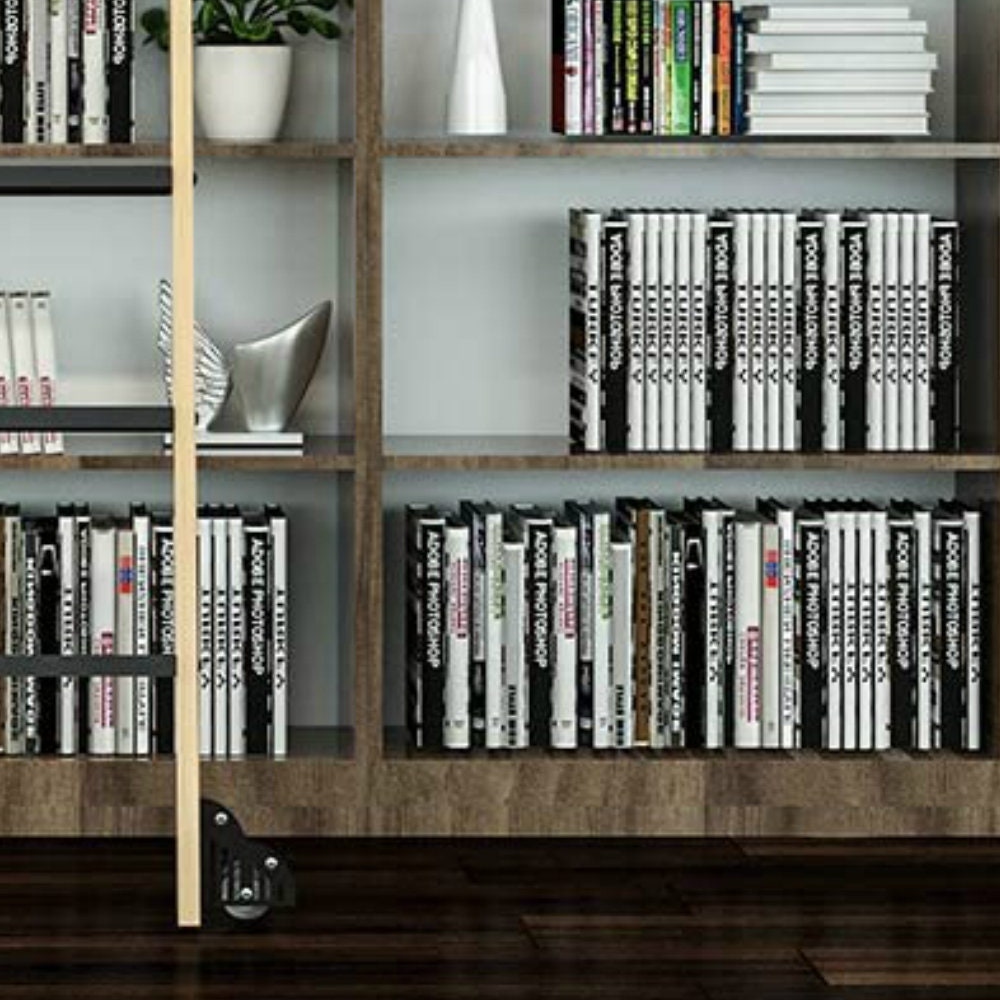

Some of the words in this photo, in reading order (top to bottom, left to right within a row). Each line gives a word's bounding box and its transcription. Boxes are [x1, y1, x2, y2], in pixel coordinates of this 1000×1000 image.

[252, 538, 264, 587] ADOBE
[427, 530, 441, 579] ADOBE
[534, 530, 548, 579] ADOBE
[806, 531, 819, 579] ADOBE
[896, 531, 909, 579] ADOBE
[945, 531, 958, 579] ADOBE
[162, 589, 174, 656] PHOTOSH
